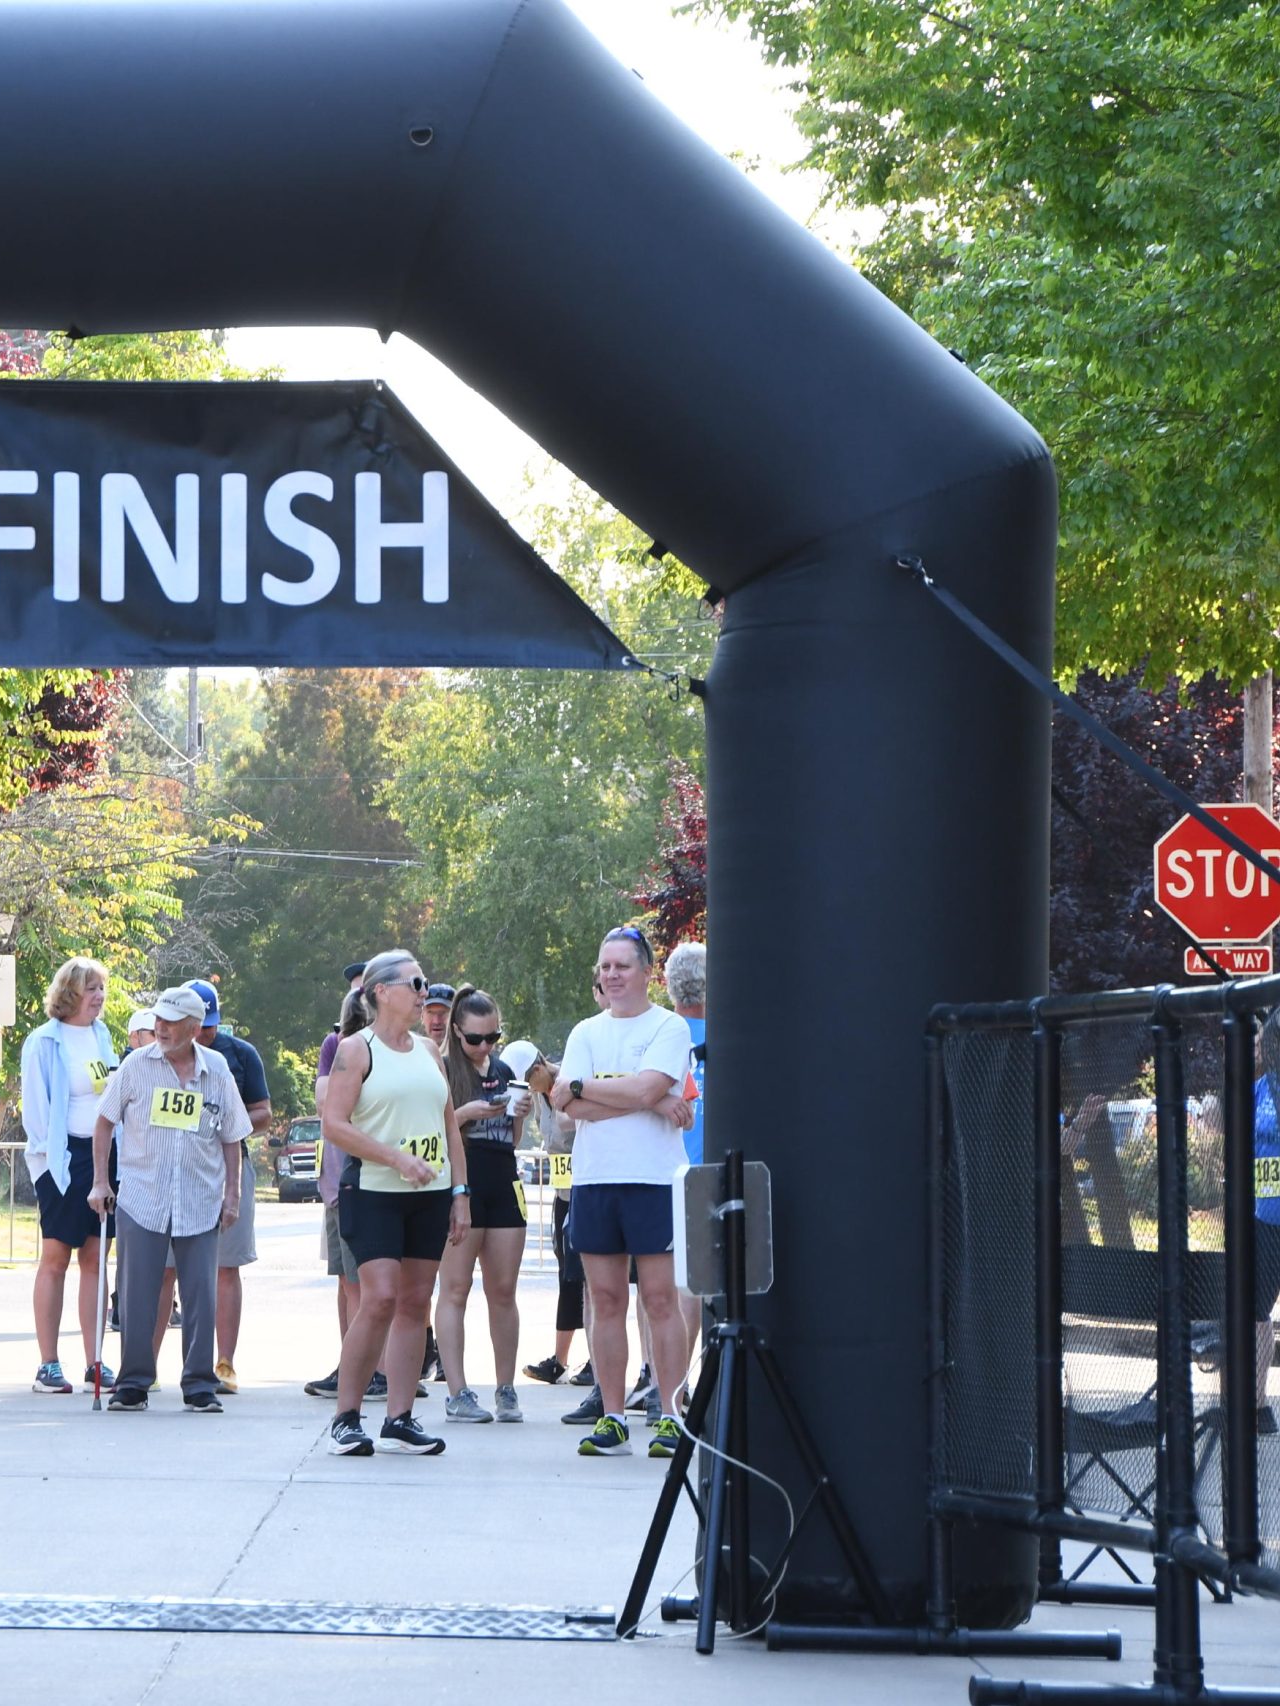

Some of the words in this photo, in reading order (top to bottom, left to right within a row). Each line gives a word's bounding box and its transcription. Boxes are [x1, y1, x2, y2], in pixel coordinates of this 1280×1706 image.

[1232, 953, 1264, 969] WAY
[90, 1060, 109, 1080] 10
[160, 1091, 196, 1116] 158
[409, 1136, 438, 1162] 129
[1256, 1160, 1280, 1182] 103
